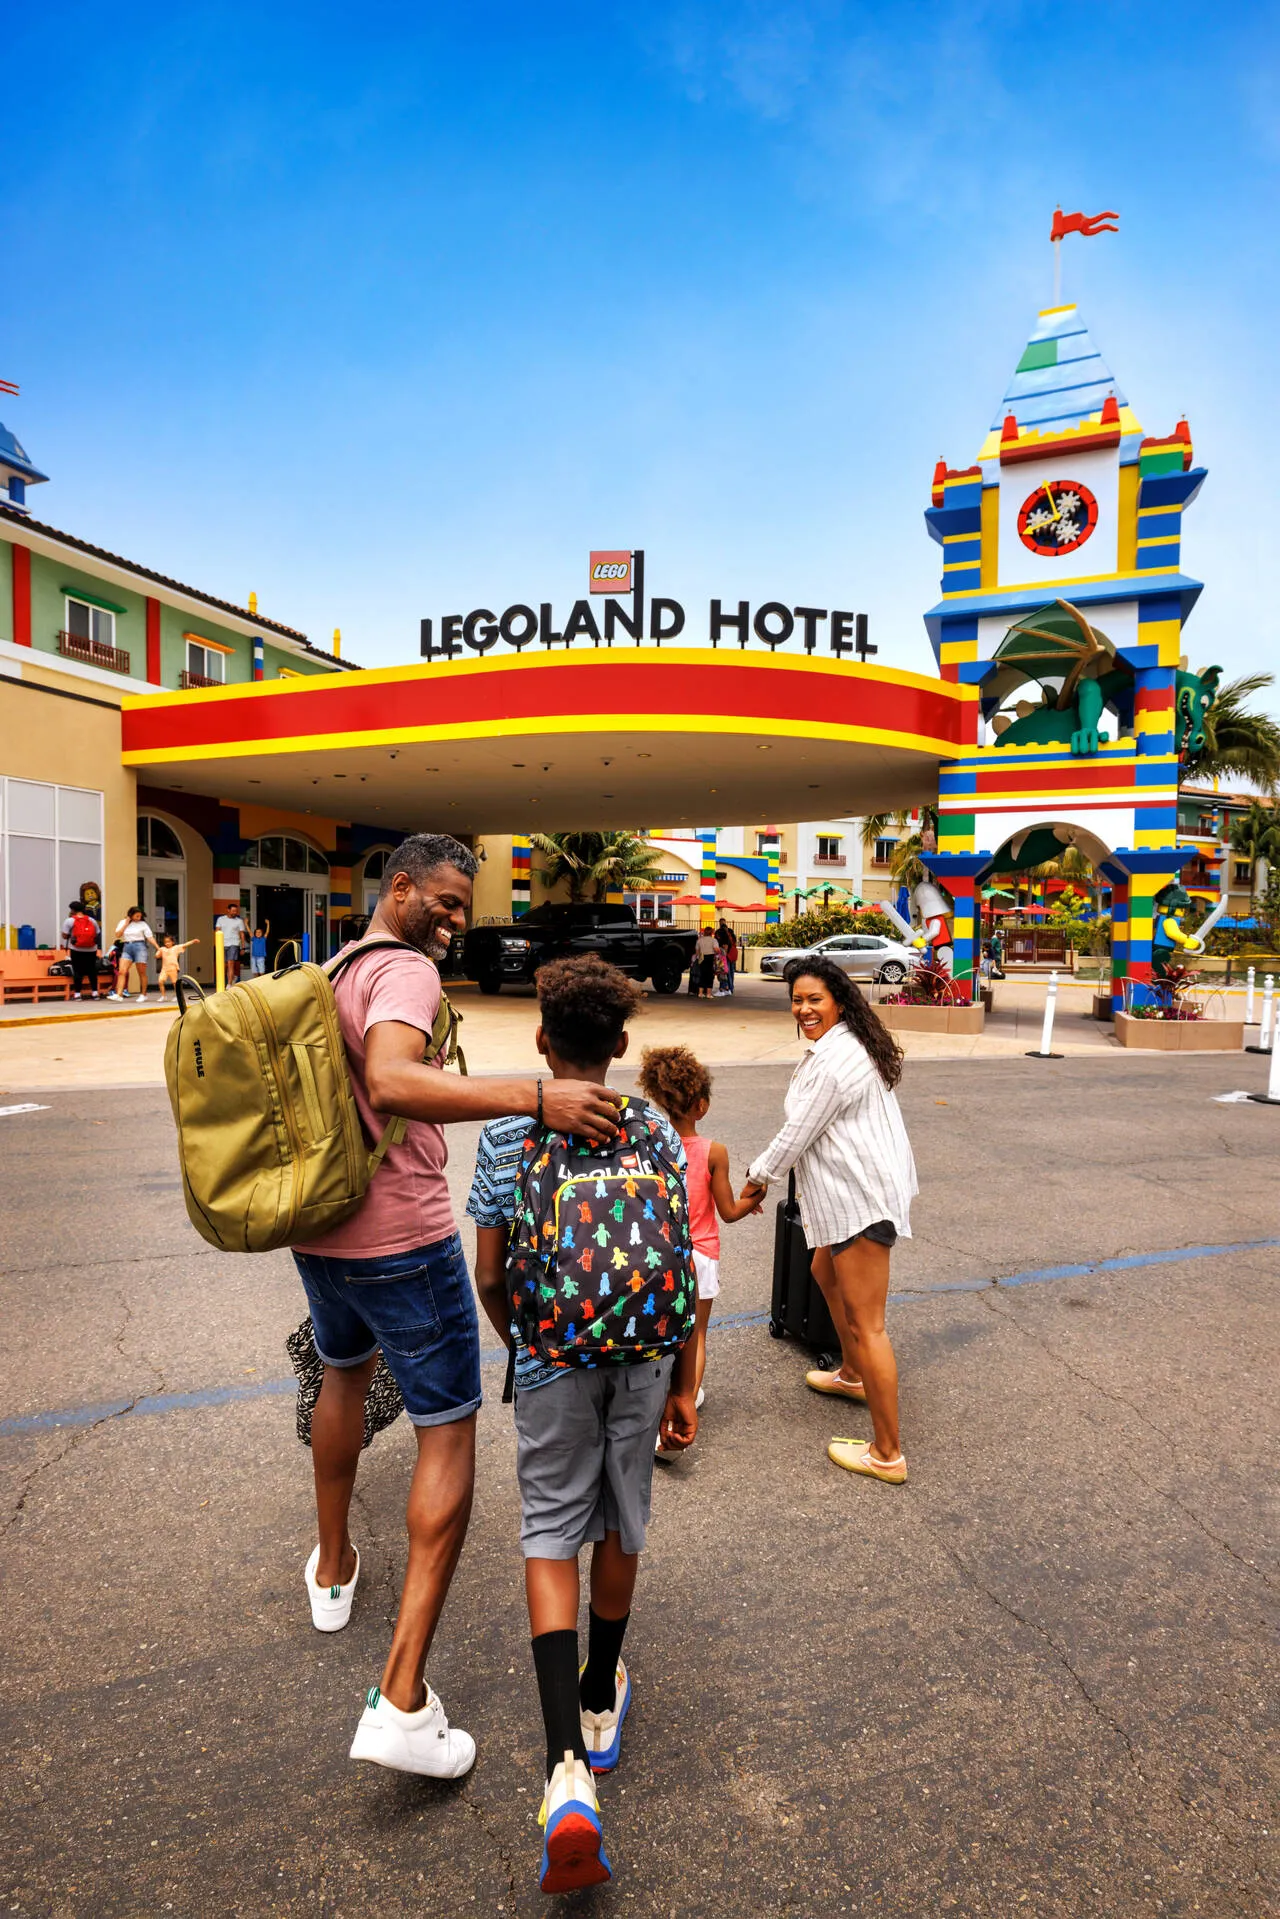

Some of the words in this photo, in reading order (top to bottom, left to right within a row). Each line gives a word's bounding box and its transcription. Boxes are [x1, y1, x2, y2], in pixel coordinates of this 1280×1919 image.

[592, 562, 629, 580] LEGO
[420, 550, 685, 657] LEGOLAND
[710, 598, 878, 654] HOTEL
[193, 1039, 205, 1078] THULE
